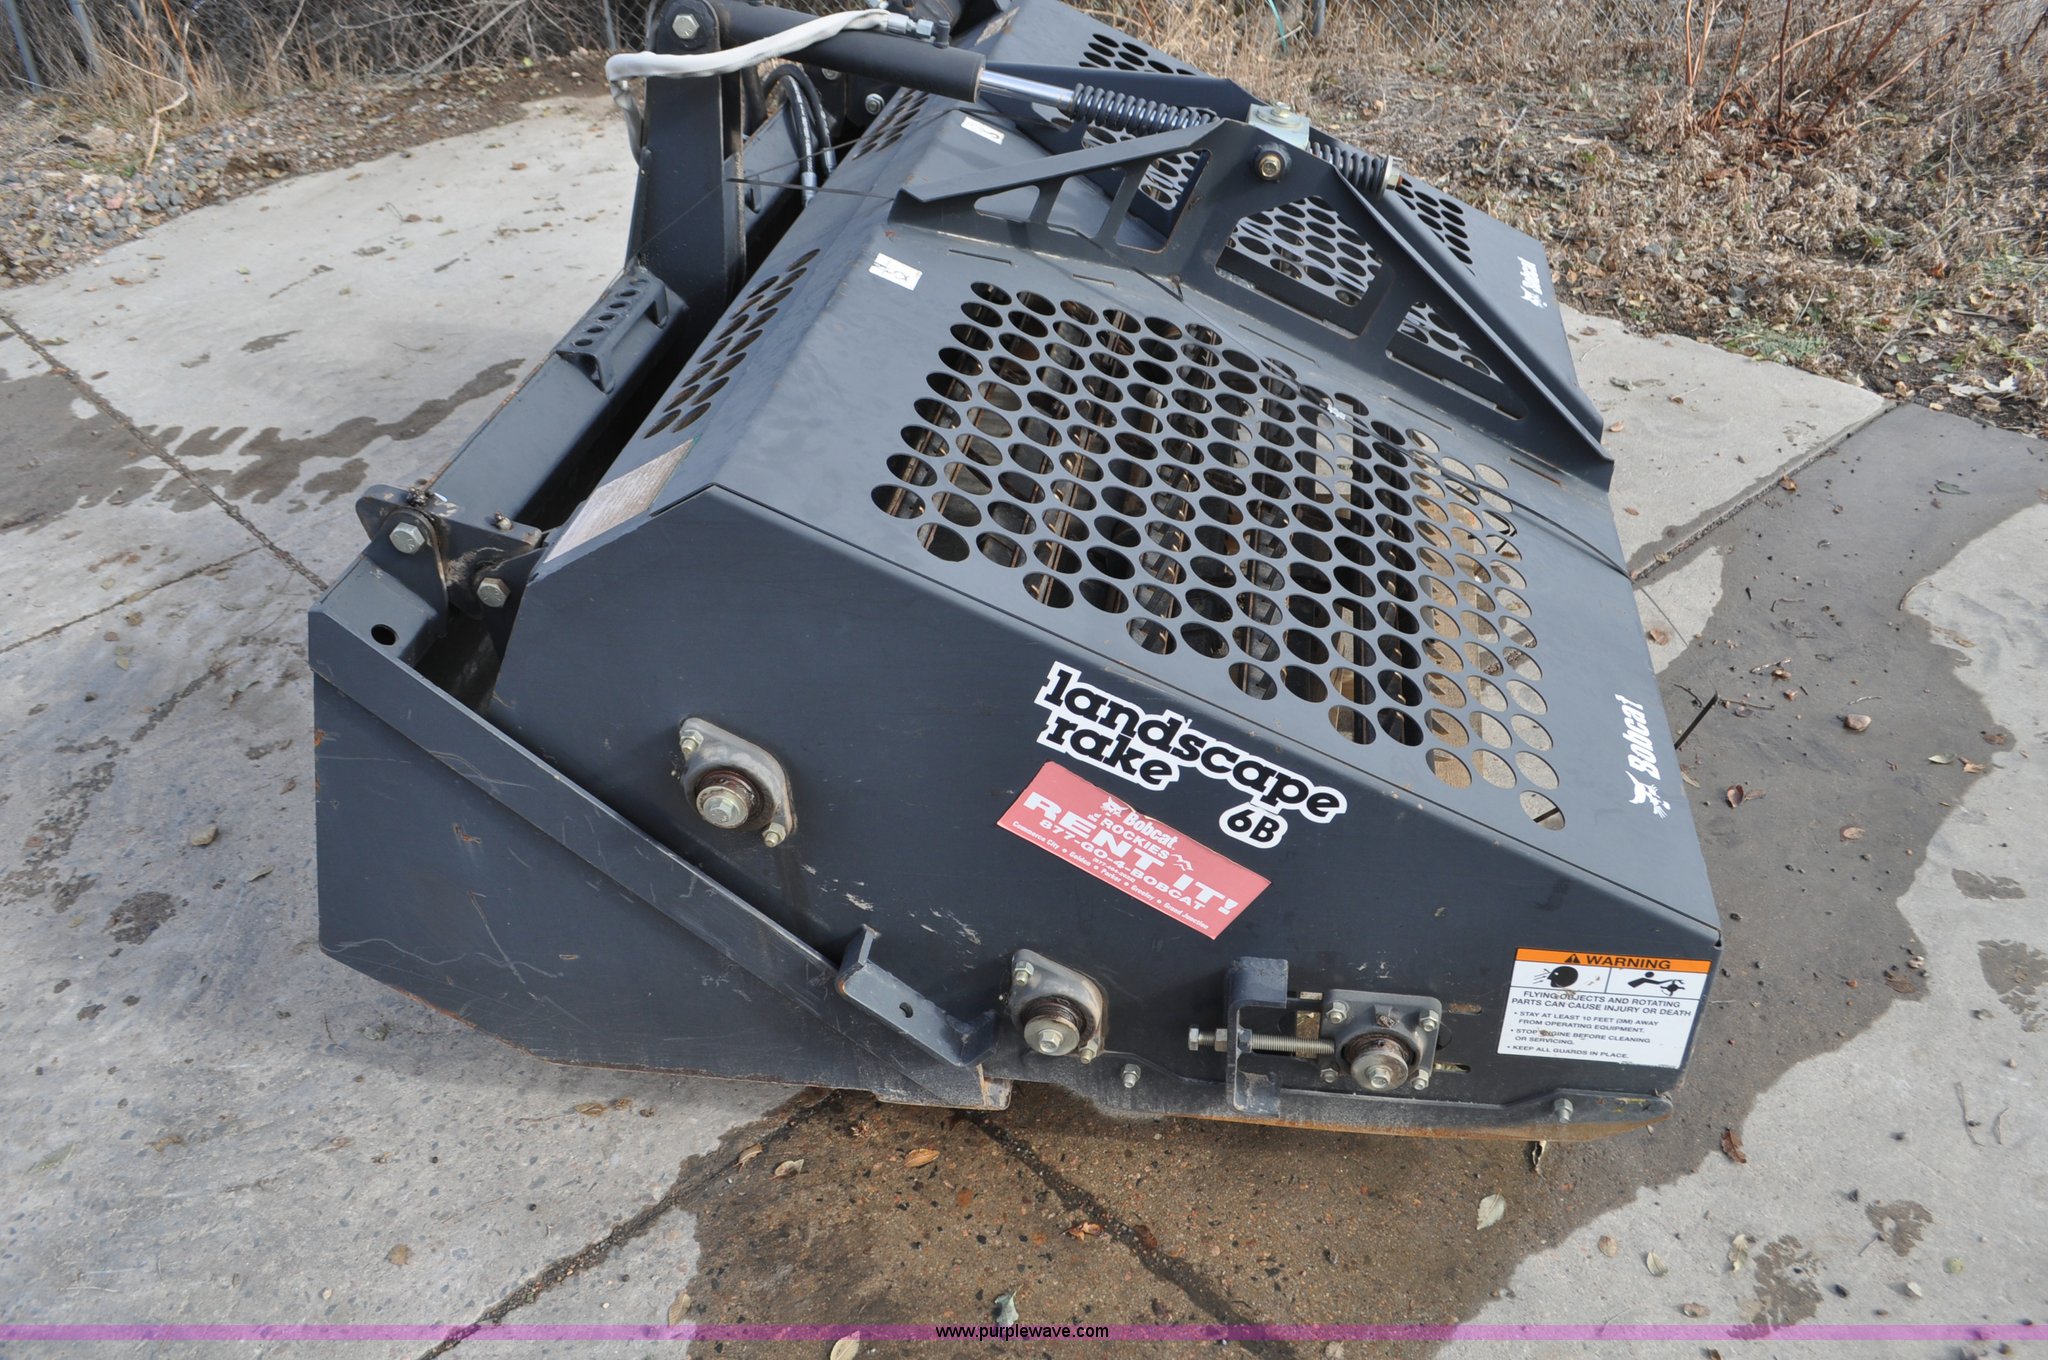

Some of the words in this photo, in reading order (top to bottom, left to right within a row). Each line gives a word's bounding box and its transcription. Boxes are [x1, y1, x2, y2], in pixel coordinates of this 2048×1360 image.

[1044, 669, 1339, 817] landscape
[1046, 716, 1172, 785] rake
[1614, 694, 1661, 780] Bobcat
[1101, 818, 1169, 859] ROCKIES
[1227, 809, 1280, 842] 6B
[1024, 792, 1164, 870] RENT
[1173, 874, 1238, 915] IT!
[1040, 820, 1205, 910] 877-GO-4-BOBCAT
[1046, 838, 1060, 850] City
[1069, 852, 1091, 866] Golden
[1101, 869, 1121, 882] Parker
[1131, 885, 1154, 900] Greeley
[1164, 903, 1183, 915] Grand
[1585, 955, 1672, 969] WARNING
[1511, 997, 1542, 1006] PARTS
[1567, 1002, 1602, 1010] CAUSE
[1603, 1004, 1640, 1013] INJURY
[1658, 1008, 1692, 1016] DEATH
[1523, 990, 1558, 999] FLYING
[1559, 993, 1605, 1002] OBJECTS
[1607, 996, 1629, 1004] AND
[1631, 998, 1681, 1007] ROTATING
[1544, 1020, 1592, 1029] OPERATING
[1607, 1035, 1651, 1043] CLEANING
